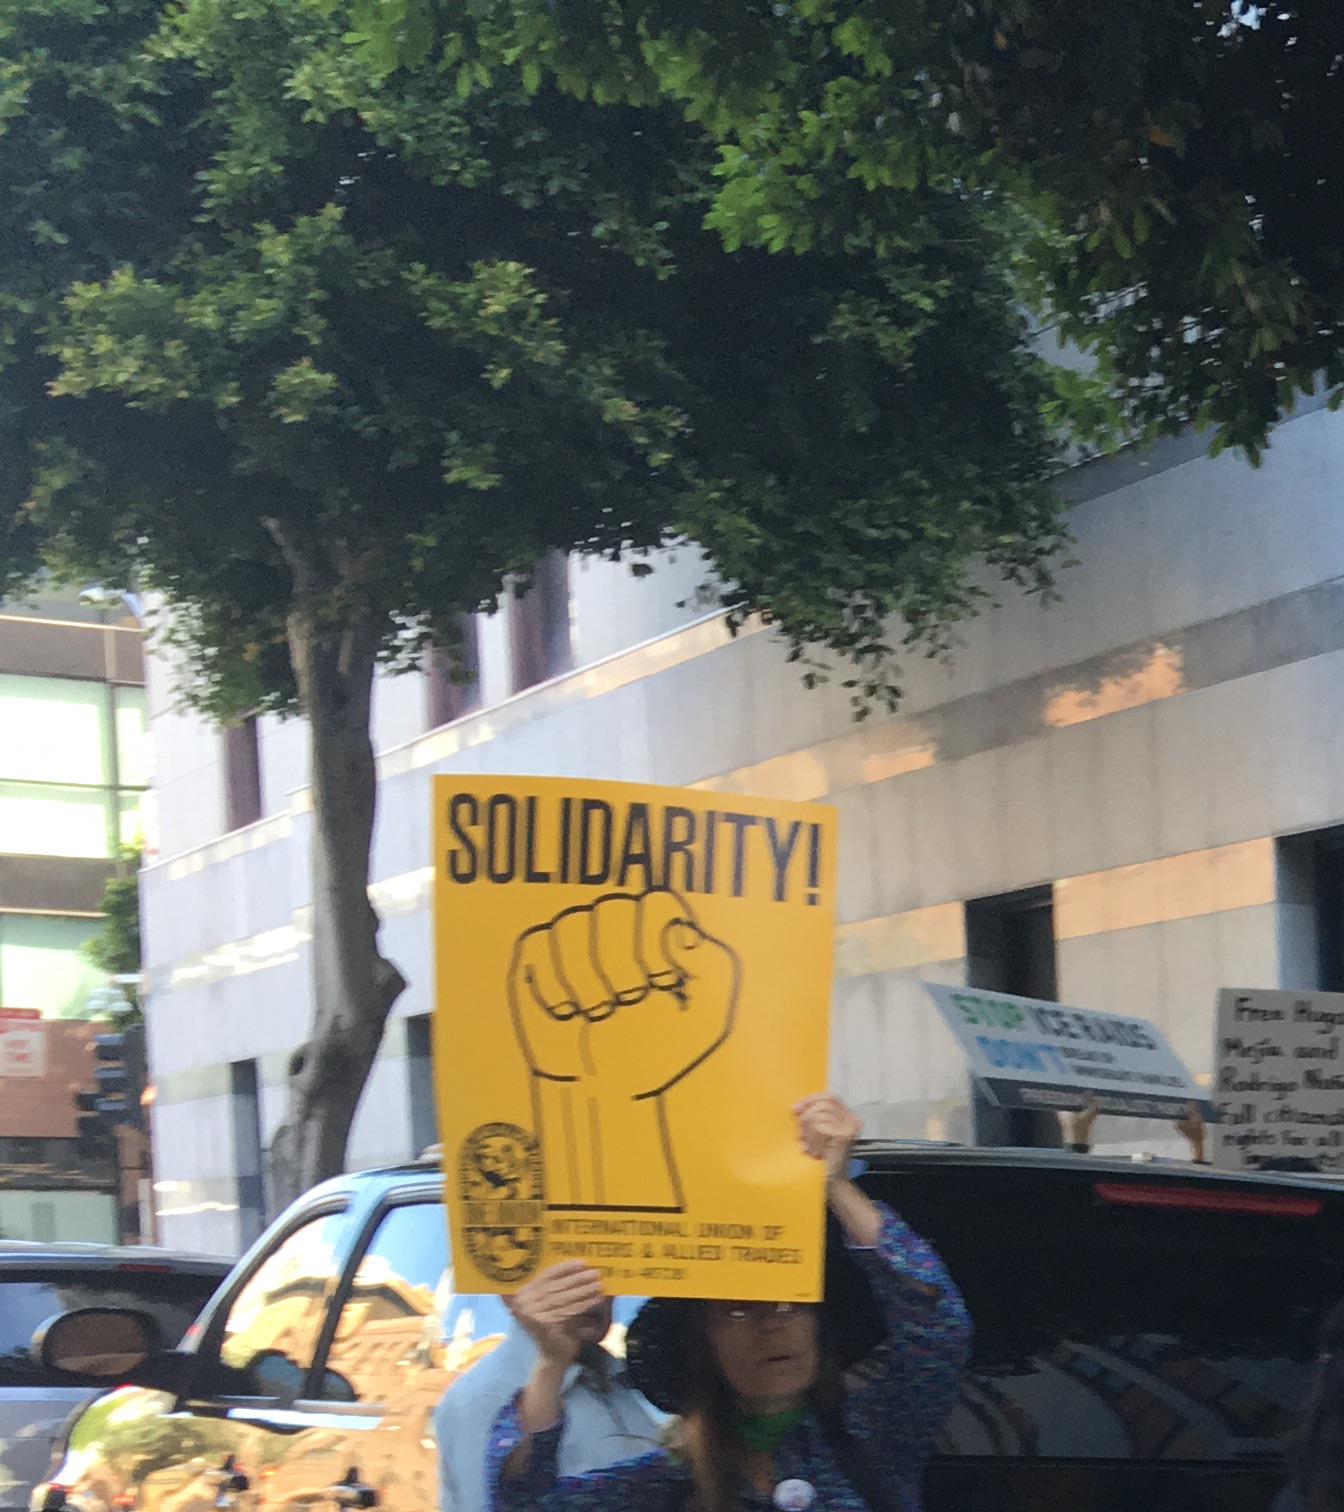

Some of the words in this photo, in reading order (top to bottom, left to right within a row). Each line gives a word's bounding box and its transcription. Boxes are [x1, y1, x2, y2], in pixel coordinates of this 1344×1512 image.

[447, 792, 824, 906] SOLIDARITY!
[1025, 1005, 1083, 1040] ICE
[1235, 996, 1285, 1022] Free
[1293, 1037, 1340, 1060] and
